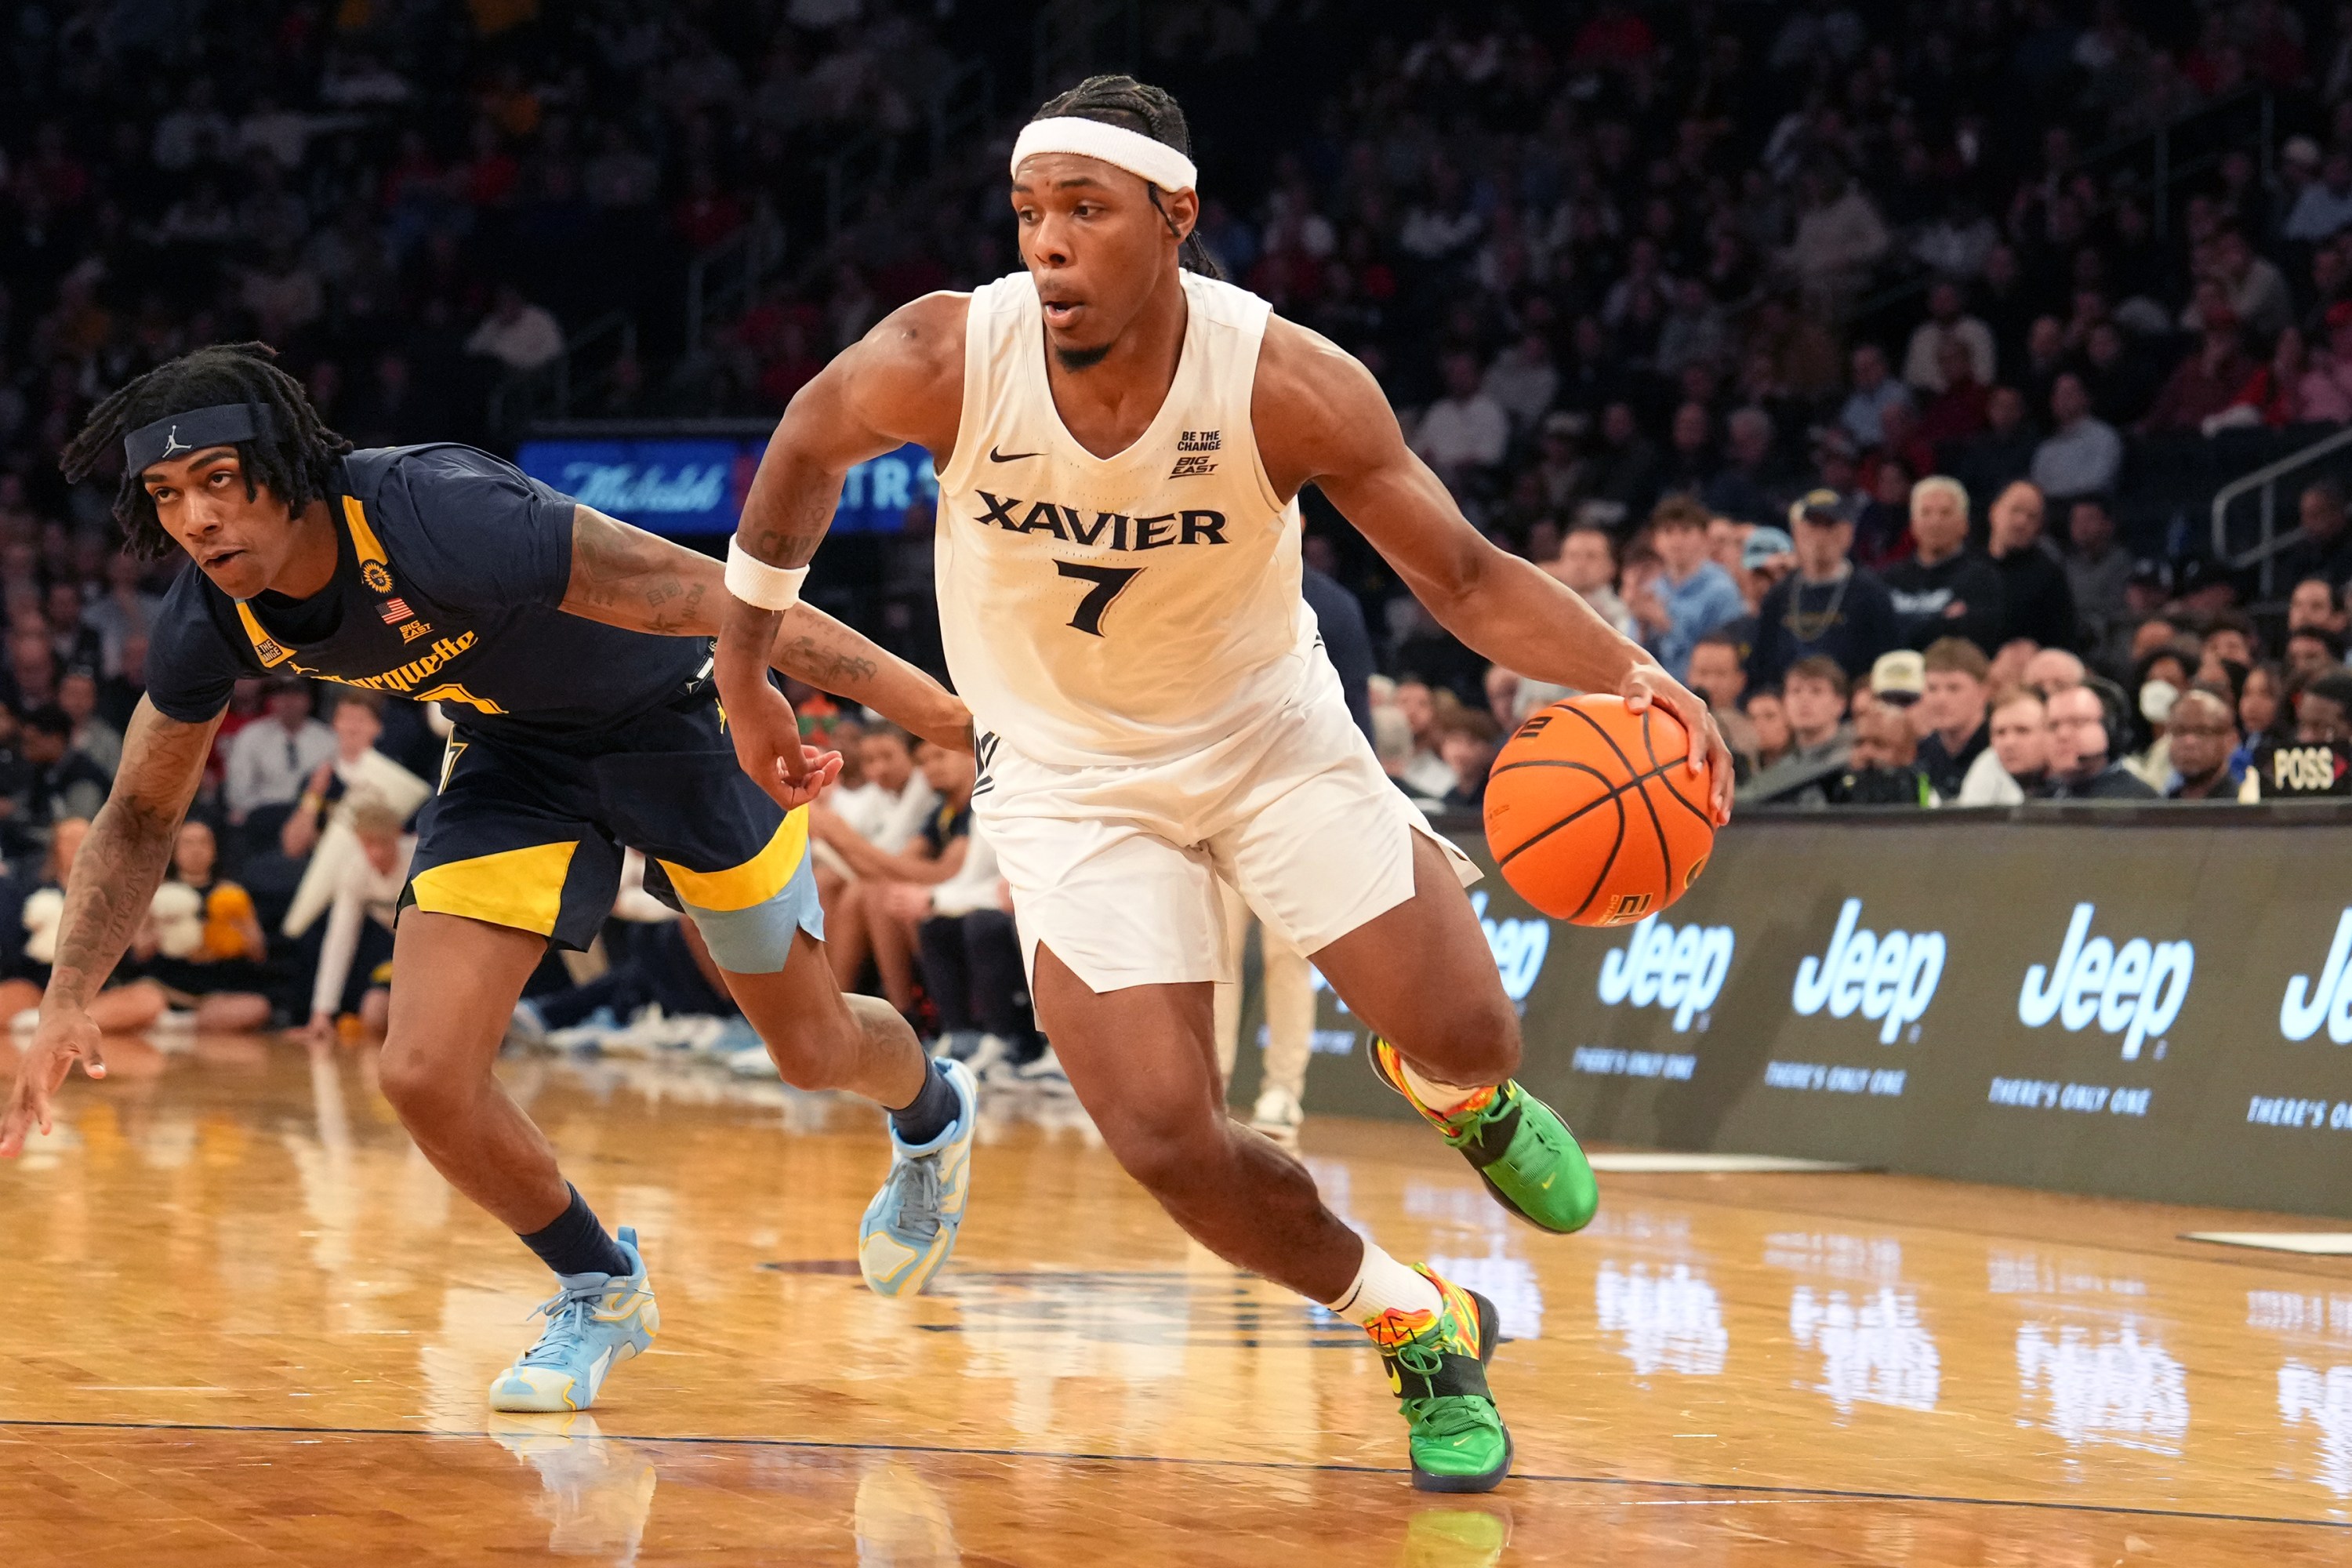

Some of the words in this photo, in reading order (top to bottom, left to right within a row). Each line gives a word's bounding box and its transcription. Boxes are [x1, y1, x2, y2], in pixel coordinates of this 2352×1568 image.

[1181, 430, 1196, 441] BE
[1200, 430, 1220, 441] THE
[1177, 440, 1221, 452] CHANGE
[1171, 463, 1218, 475] EAST
[1176, 456, 1210, 466] BIG
[973, 489, 1232, 552] XAVIER
[1052, 558, 1149, 637] 7
[399, 620, 421, 633] BIG
[402, 623, 431, 640] EAST
[259, 640, 274, 654] THE
[2274, 747, 2334, 790] POSS
[1598, 912, 1735, 1033] Jeep
[1792, 898, 1947, 1045] Jeep
[2018, 902, 2196, 1061] Jeep
